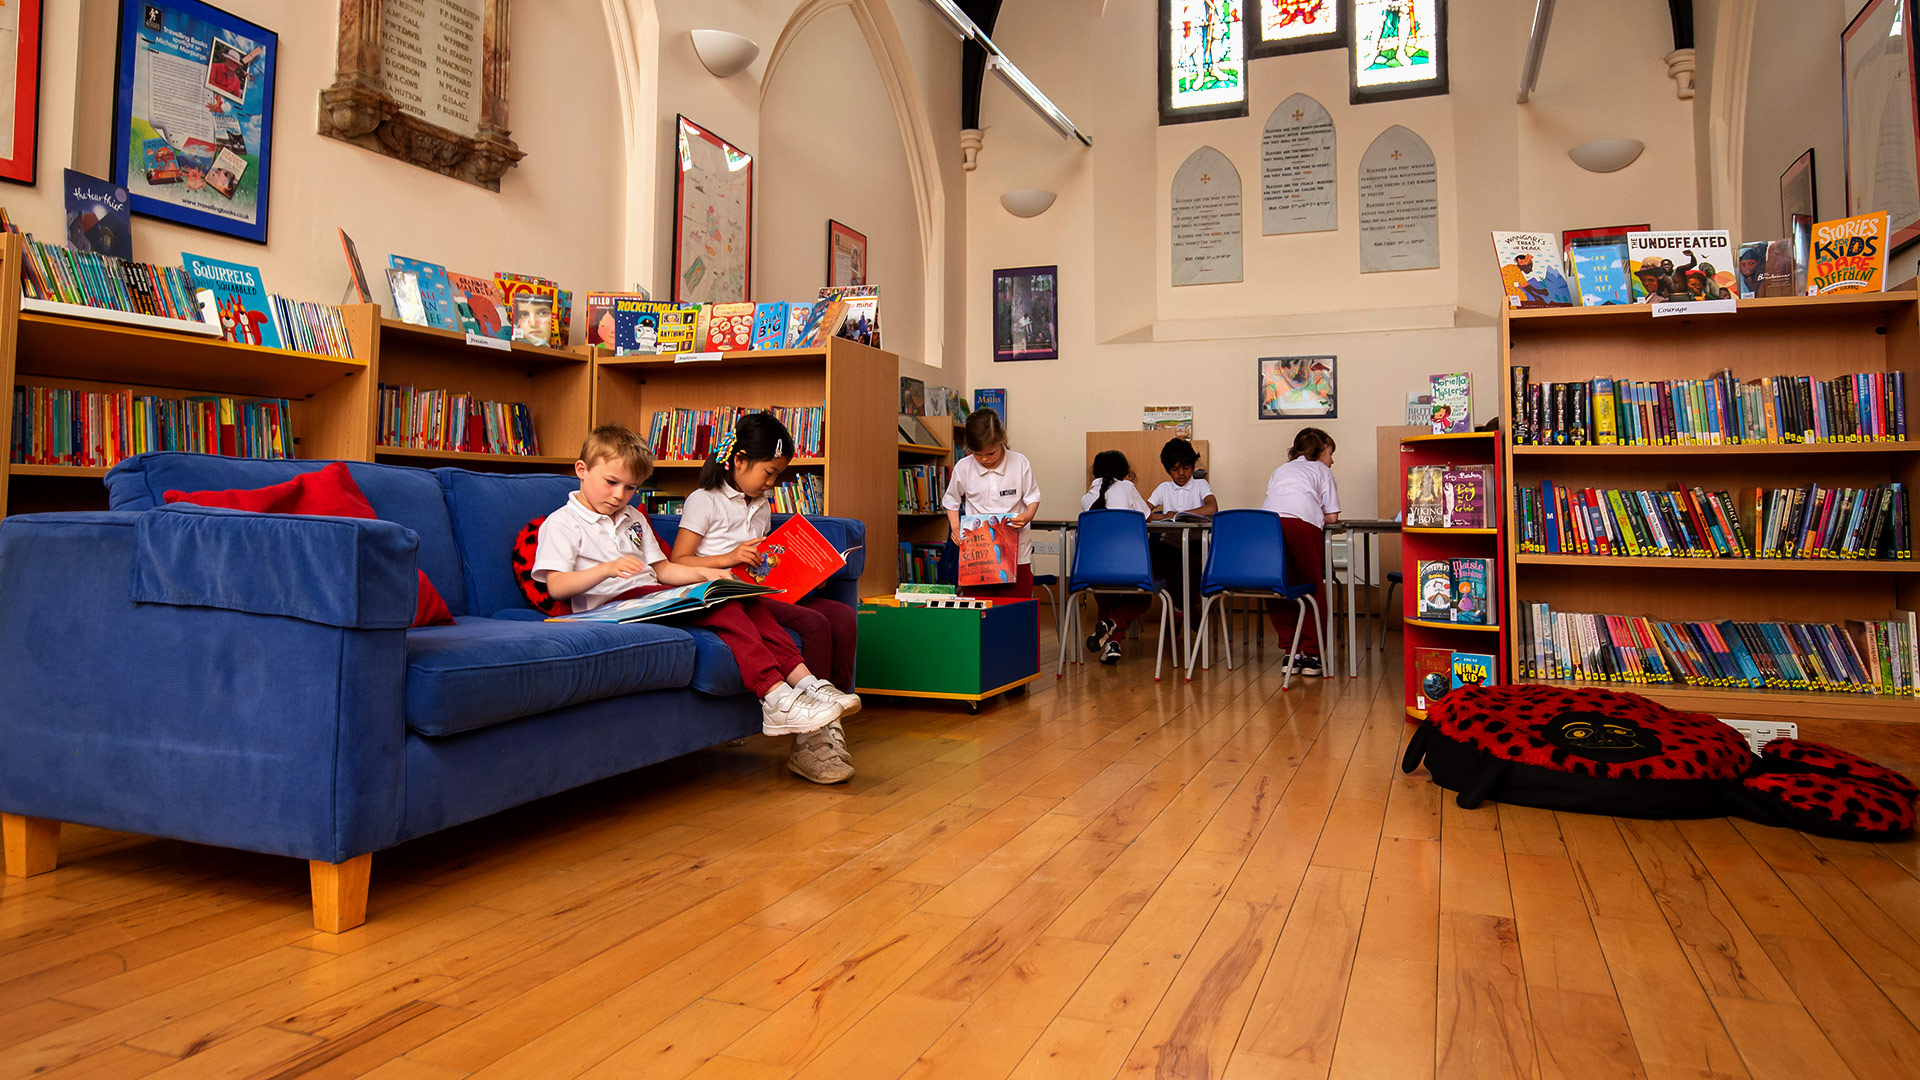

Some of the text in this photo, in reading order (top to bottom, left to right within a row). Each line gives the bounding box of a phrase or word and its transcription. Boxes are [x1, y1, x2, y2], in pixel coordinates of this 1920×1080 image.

[163, 26, 208, 49] Travelling Books
[396, 36, 422, 54] THOMAS
[156, 36, 207, 61] Michael Morpurgo
[392, 60, 420, 77] GORDON
[395, 86, 422, 103] HUTSON
[446, 83, 469, 100] PEARCE
[1505, 234, 1546, 245] WANGARI'S
[1818, 218, 1880, 245] STORIES
[1638, 236, 1727, 249] UNDEFEATED
[1814, 236, 1879, 260] KIDS
[192, 260, 255, 287] SQUIRRELS
[1817, 256, 1874, 277] DARE
[1814, 267, 1878, 290] DIFFERENT
[196, 279, 257, 296] WHO SQUABBLED
[456, 283, 495, 296] MANDELA
[617, 301, 678, 313] ROCKETMOLE
[760, 312, 782, 326] DREAM
[758, 320, 781, 338] BIG
[1433, 376, 1466, 386] Mariella
[1434, 387, 1464, 400] Mystery
[1454, 483, 1476, 501] Boy
[1410, 508, 1442, 516] VIKING
[1724, 498, 1737, 521] CONTACT
[1418, 516, 1436, 524] BOY
[962, 550, 989, 562] SCARY?
[1453, 560, 1484, 571] Maisie
[1454, 663, 1487, 678] NINJA
[1462, 674, 1478, 682] KID
